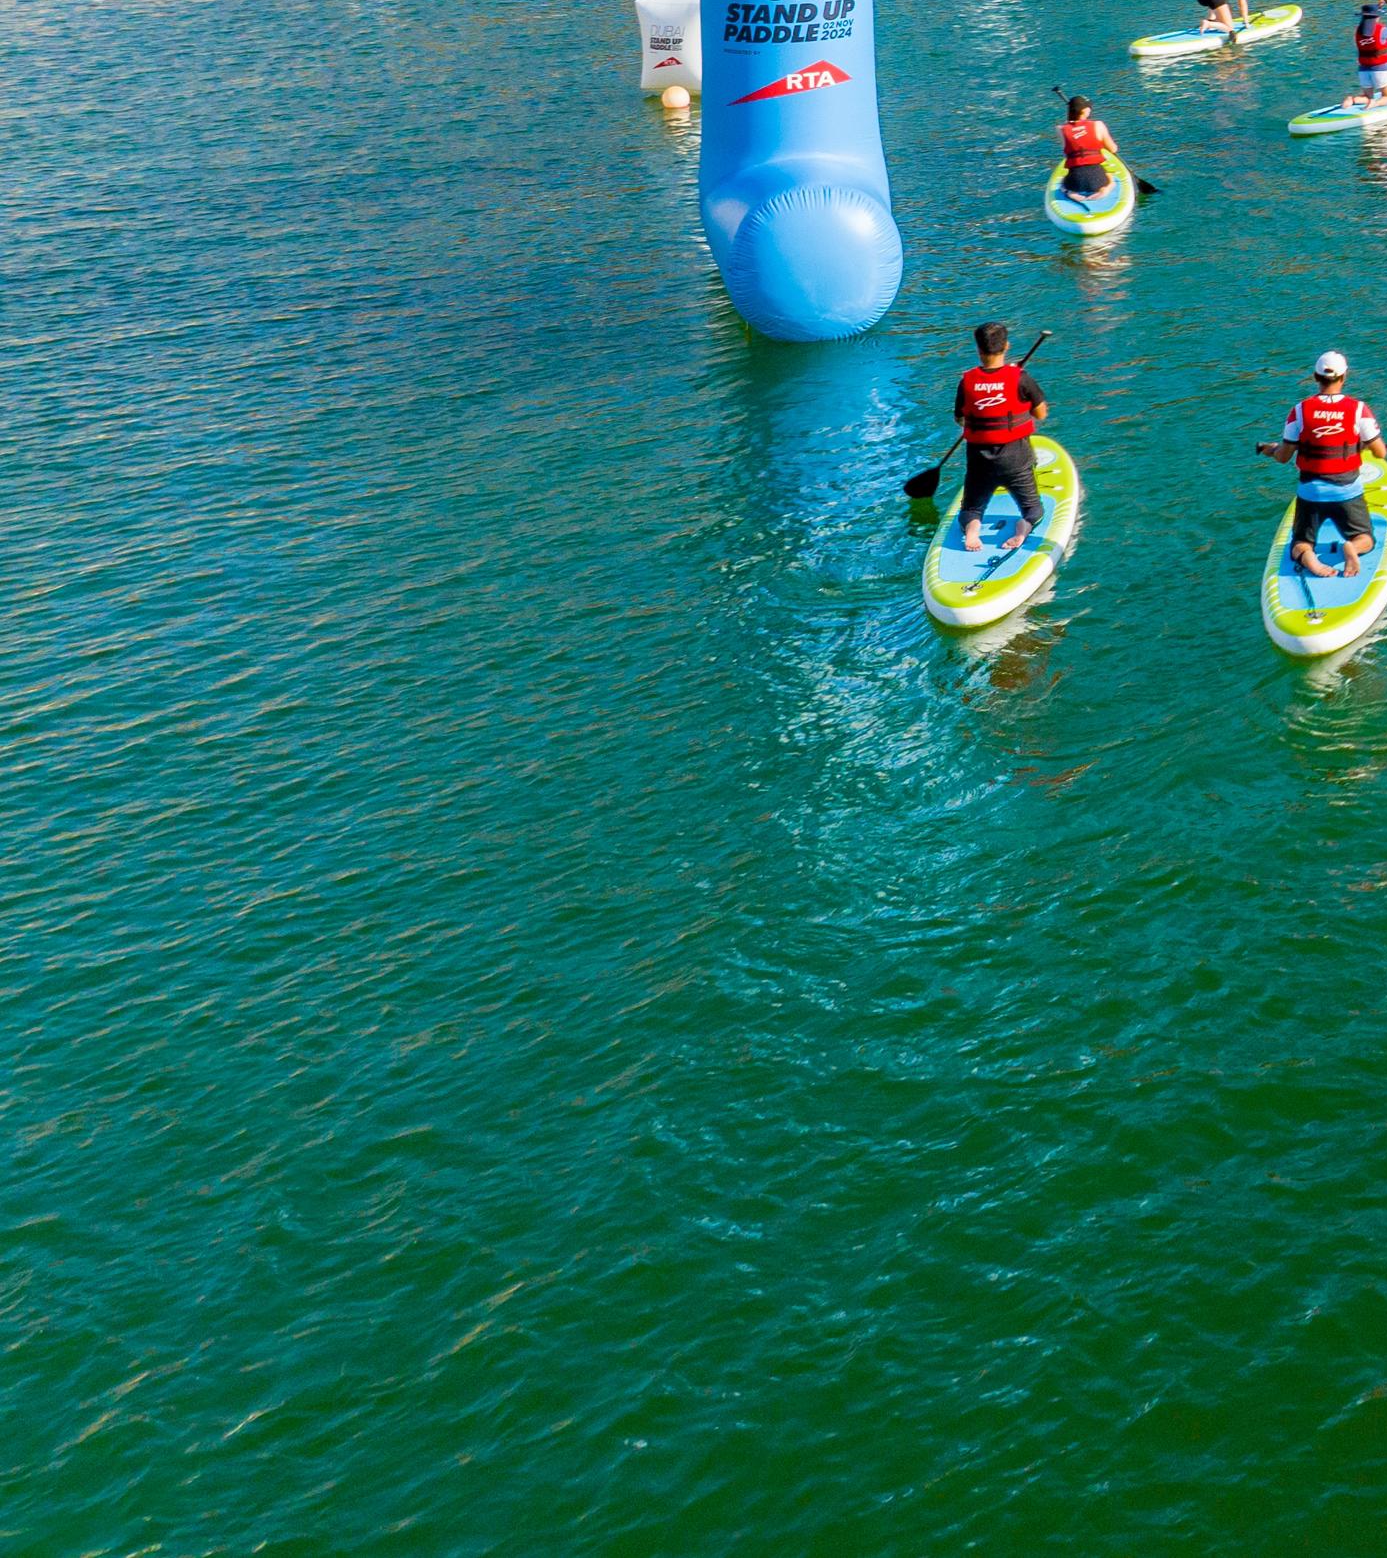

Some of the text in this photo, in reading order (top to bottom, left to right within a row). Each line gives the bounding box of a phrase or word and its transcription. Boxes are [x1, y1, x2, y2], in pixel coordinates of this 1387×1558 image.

[726, 2, 818, 24] STAND
[822, 18, 854, 29] 02 NOV
[649, 24, 686, 37] DUBAI
[723, 23, 820, 43] PADDLE
[820, 27, 853, 41] 2024
[785, 70, 837, 91] RTA
[974, 382, 1005, 394] KAYAK
[1313, 410, 1345, 422] KAYAK
